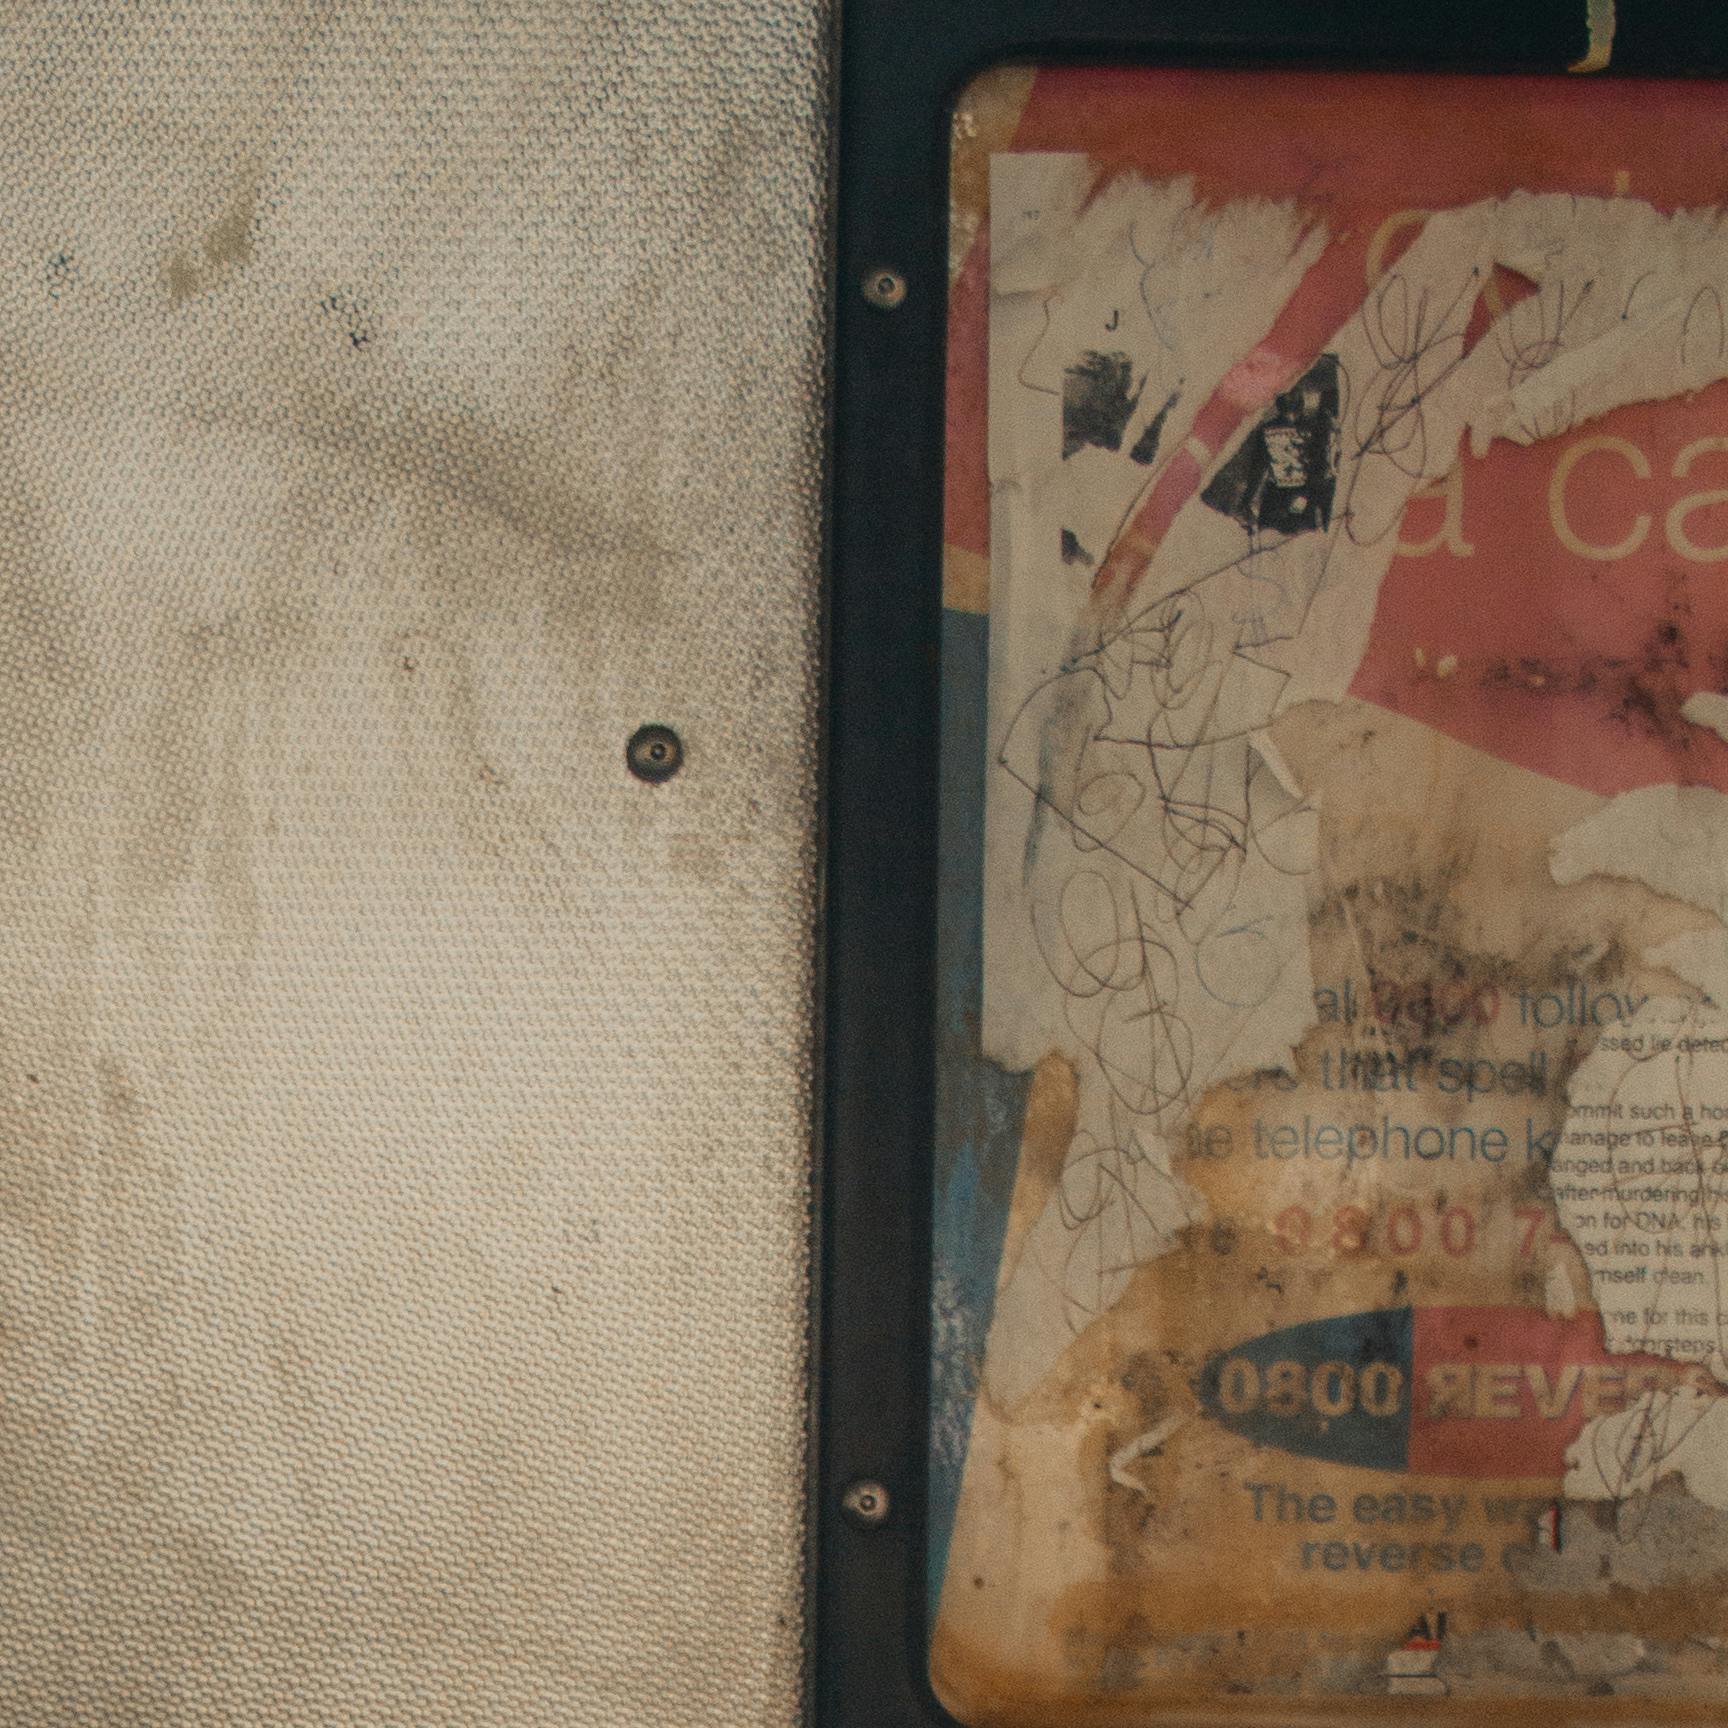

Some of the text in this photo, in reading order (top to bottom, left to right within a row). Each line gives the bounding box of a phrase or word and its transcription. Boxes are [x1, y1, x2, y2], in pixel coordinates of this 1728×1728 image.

[1438, 1051, 1548, 1101] spell
[1630, 1103, 1676, 1120] such
[1252, 1113, 1510, 1173] telephone
[1618, 1158, 1656, 1175] and
[1604, 1211, 1628, 1229] for
[1615, 1241, 1651, 1257] into
[1675, 1308, 1710, 1326] this
[1217, 1357, 1405, 1418] 0800
[1243, 1482, 1338, 1525] The
[1353, 1490, 1463, 1536] easy
[1300, 1540, 1486, 1575] reverse
